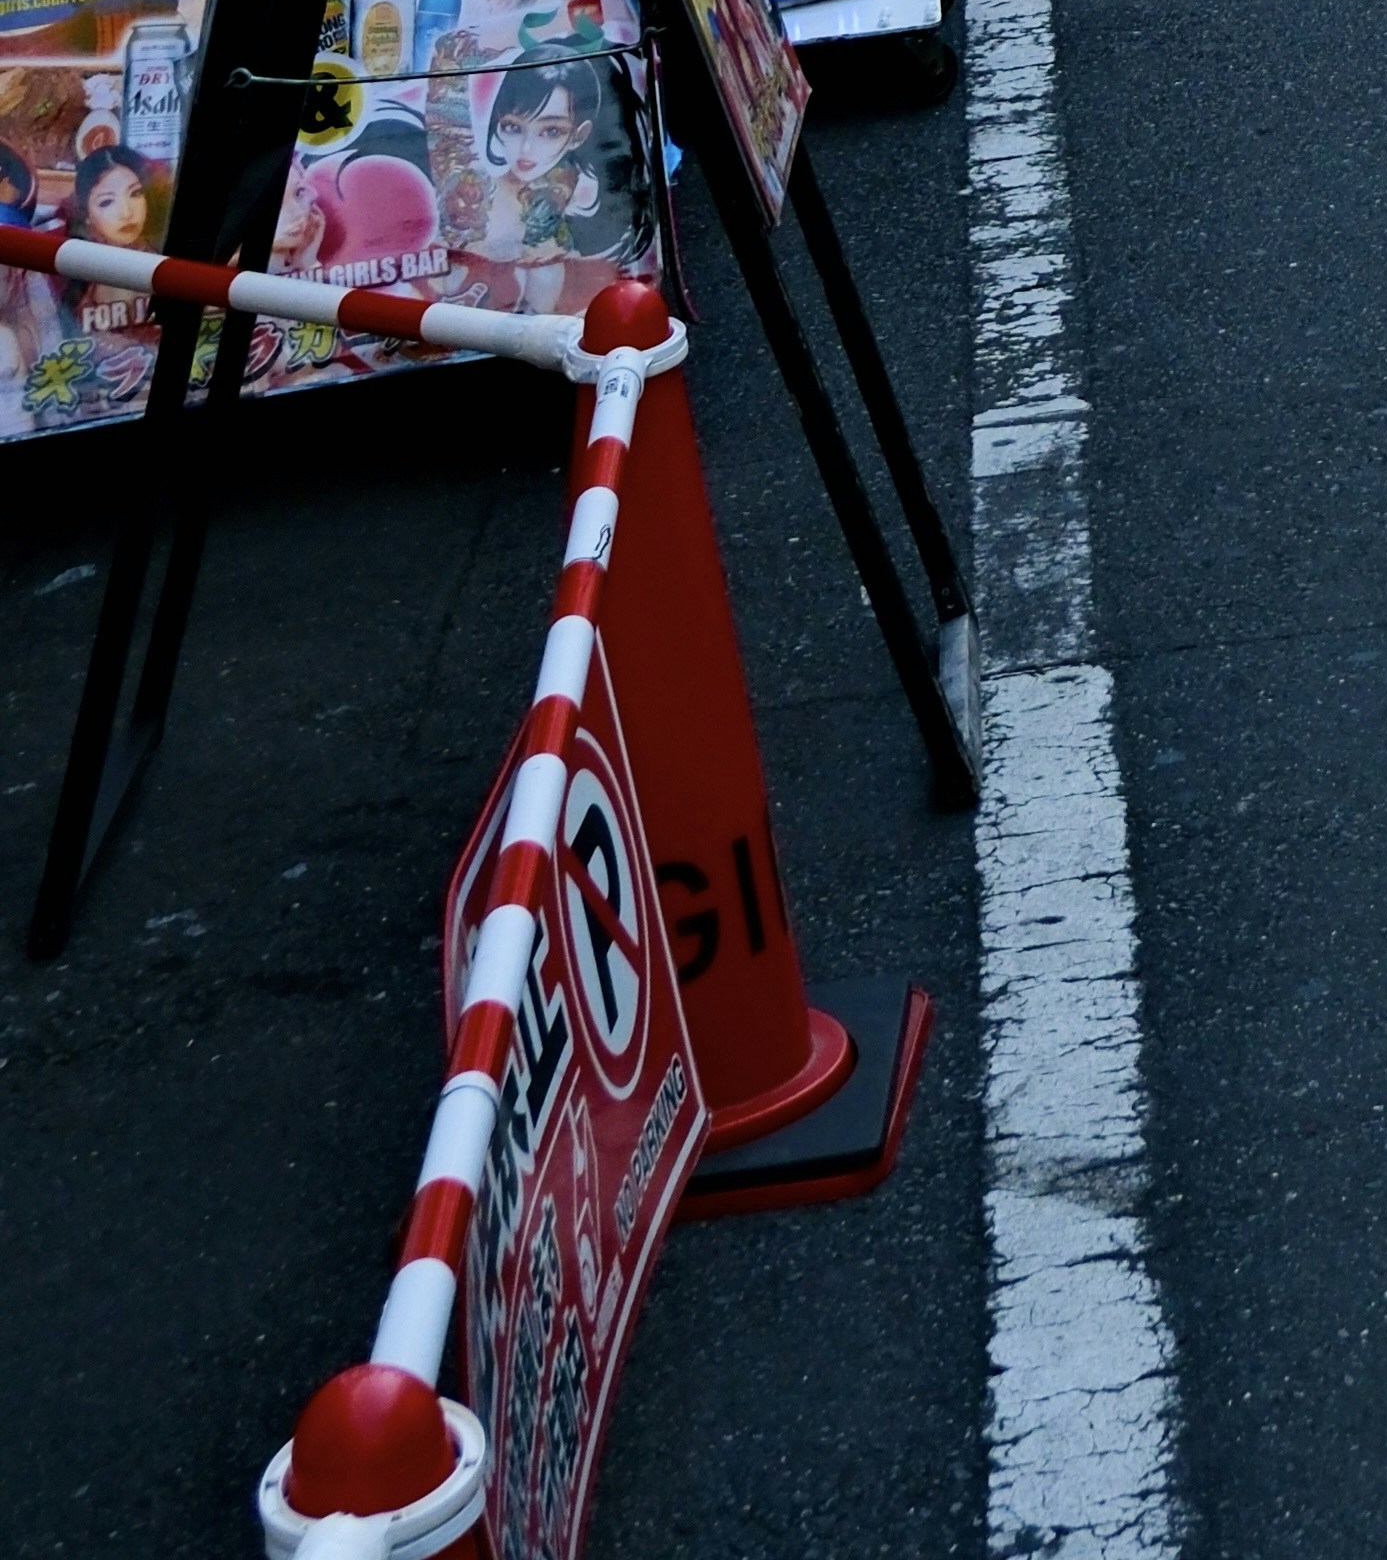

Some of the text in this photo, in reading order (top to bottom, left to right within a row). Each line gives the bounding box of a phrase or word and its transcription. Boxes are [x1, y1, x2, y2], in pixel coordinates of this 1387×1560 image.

[332, 247, 450, 288] GIRLS BAR
[81, 302, 129, 332] FOR
[631, 1053, 688, 1190] PARKING
